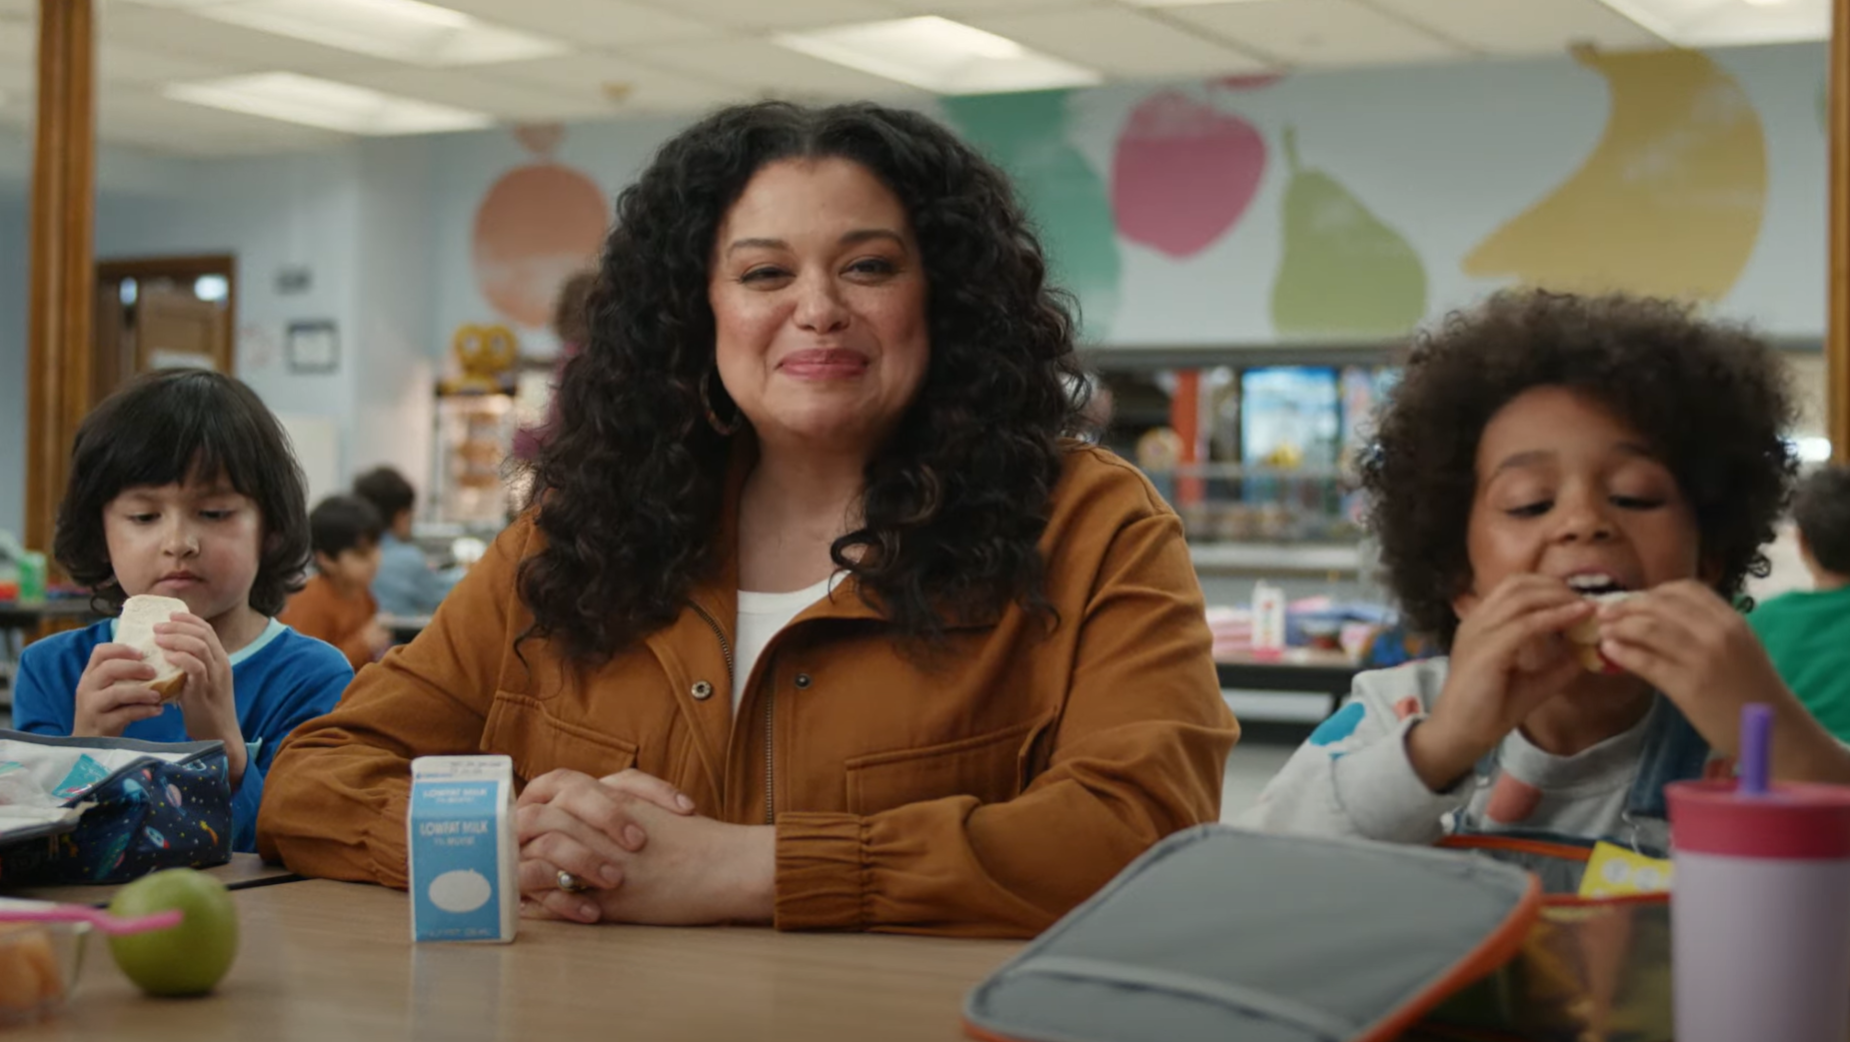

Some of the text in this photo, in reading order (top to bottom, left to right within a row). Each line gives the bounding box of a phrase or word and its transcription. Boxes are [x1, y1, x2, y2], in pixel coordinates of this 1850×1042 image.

[463, 788, 488, 797] MILK
[420, 820, 488, 836] LOWFAT MILK
